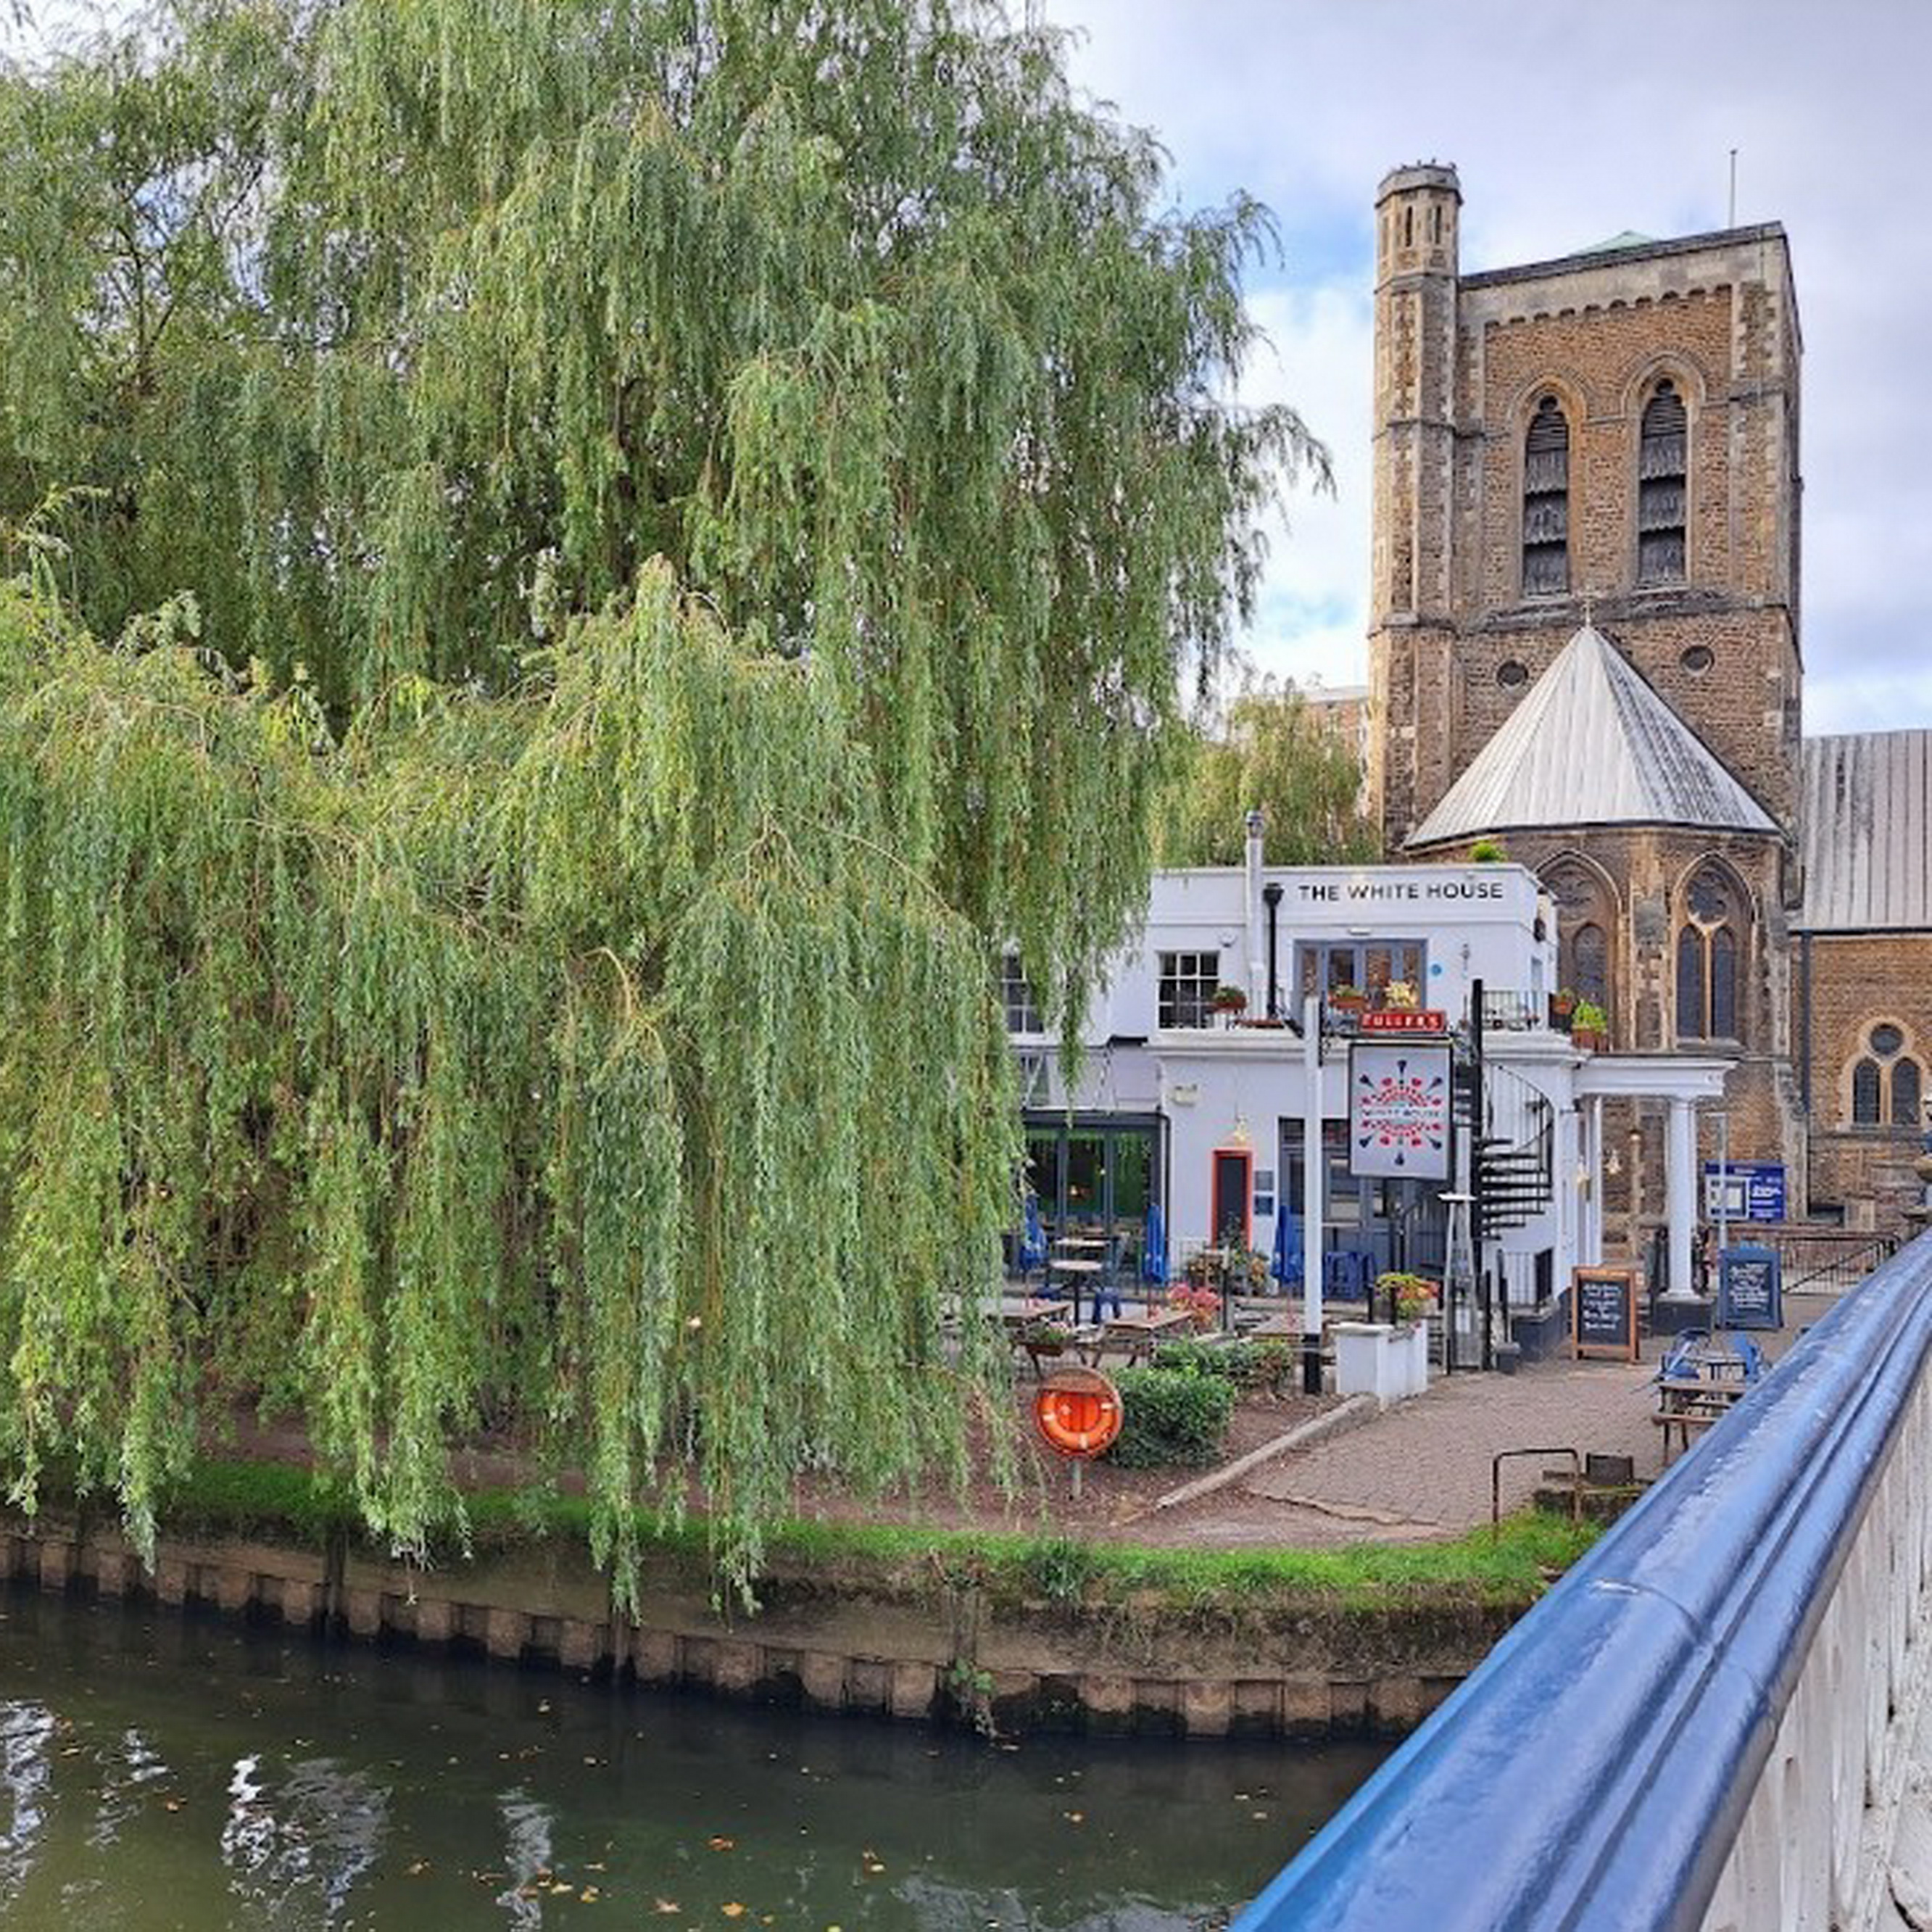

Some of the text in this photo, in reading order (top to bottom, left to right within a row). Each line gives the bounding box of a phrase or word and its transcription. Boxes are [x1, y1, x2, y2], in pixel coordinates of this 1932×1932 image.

[1298, 882, 1504, 901] THE WHITE HOUSE
